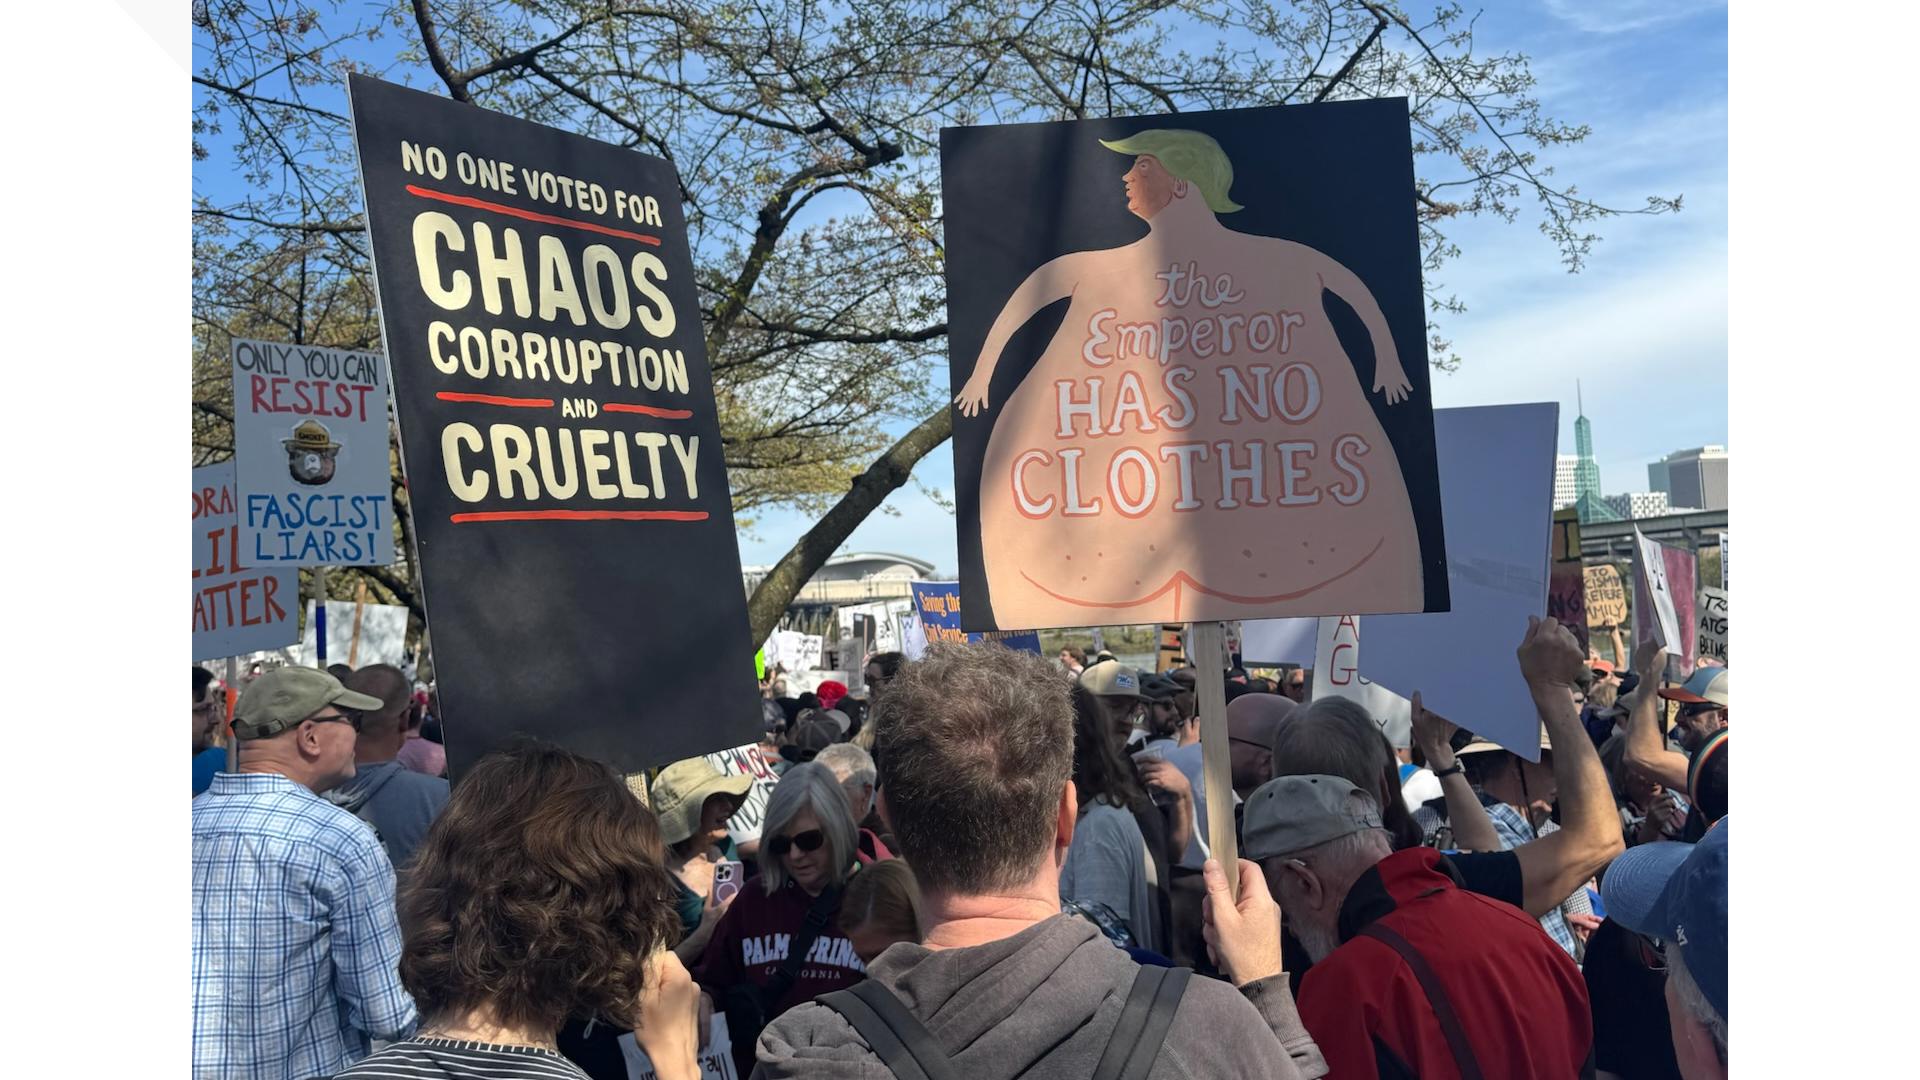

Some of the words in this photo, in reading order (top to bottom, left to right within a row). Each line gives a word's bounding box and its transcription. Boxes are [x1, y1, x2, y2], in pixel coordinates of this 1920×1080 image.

[401, 141, 447, 180] NO
[457, 152, 517, 195] ONE
[522, 168, 607, 216] VOTED
[615, 190, 662, 228] FOR
[412, 211, 676, 338] CHAOS
[1155, 260, 1245, 309] the
[428, 320, 690, 395] CORRUPTION
[1082, 306, 1305, 368] Emperor
[236, 342, 293, 377] ONLY
[300, 347, 340, 381] YOU
[343, 354, 380, 386] CAN
[251, 374, 375, 422] RESIST
[561, 397, 599, 420] AND
[1054, 365, 1199, 440] HAS
[1216, 362, 1322, 425] NO
[441, 422, 699, 503] CRUELTY
[1011, 434, 1371, 519] CLOTHES
[192, 484, 238, 520] ORA
[247, 493, 387, 531] FASCIST
[256, 531, 376, 563] LIARS!
[919, 591, 947, 617] Saving
[742, 933, 791, 967] PALM
[799, 935, 866, 973] PRIN
[765, 966, 841, 979] CAORNIA
